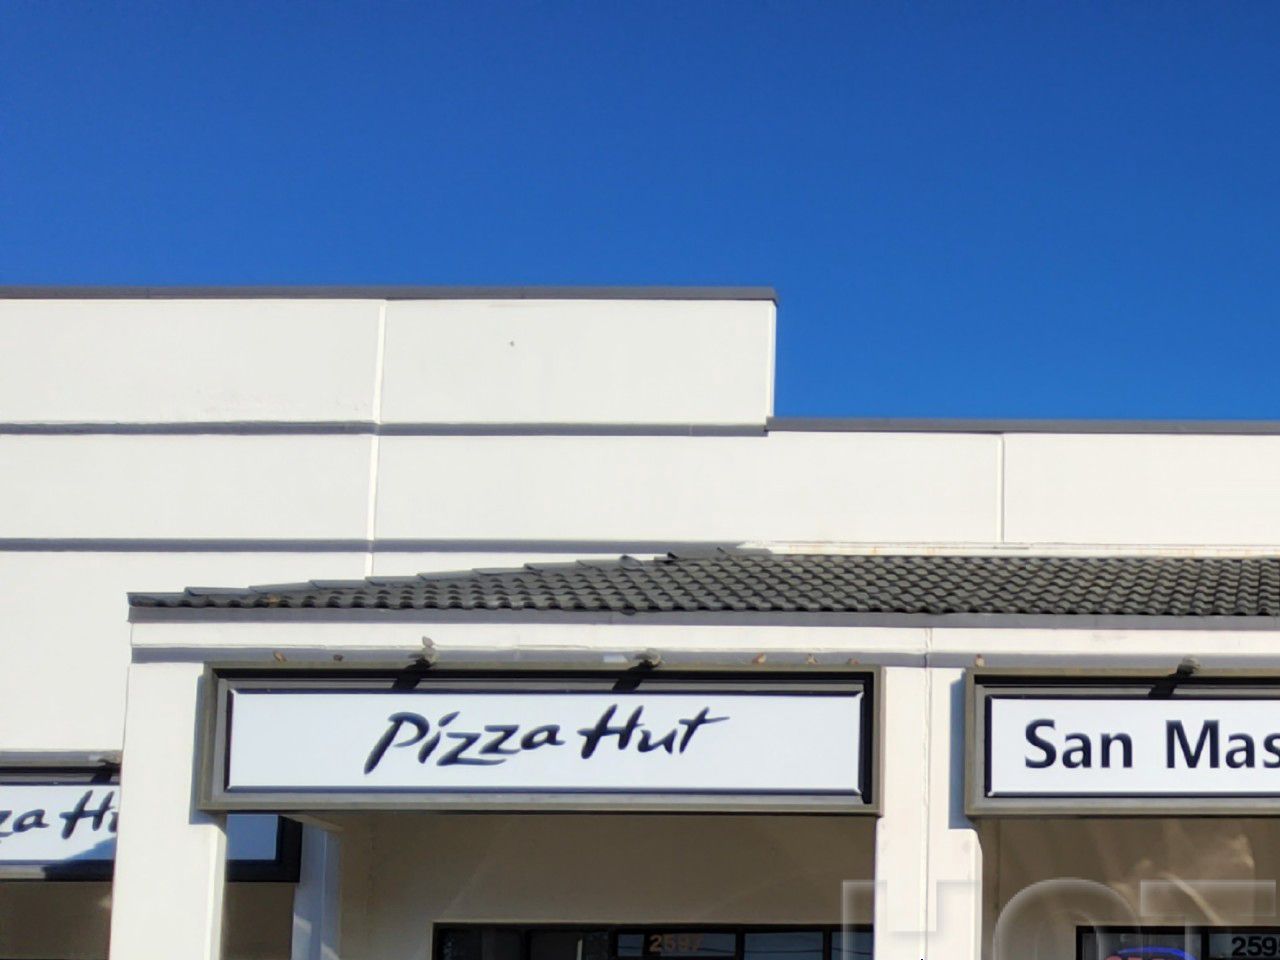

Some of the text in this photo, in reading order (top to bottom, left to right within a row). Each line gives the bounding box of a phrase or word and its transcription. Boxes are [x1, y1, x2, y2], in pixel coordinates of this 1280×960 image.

[363, 703, 731, 775] Pizza Hut
[1023, 718, 1135, 770] San
